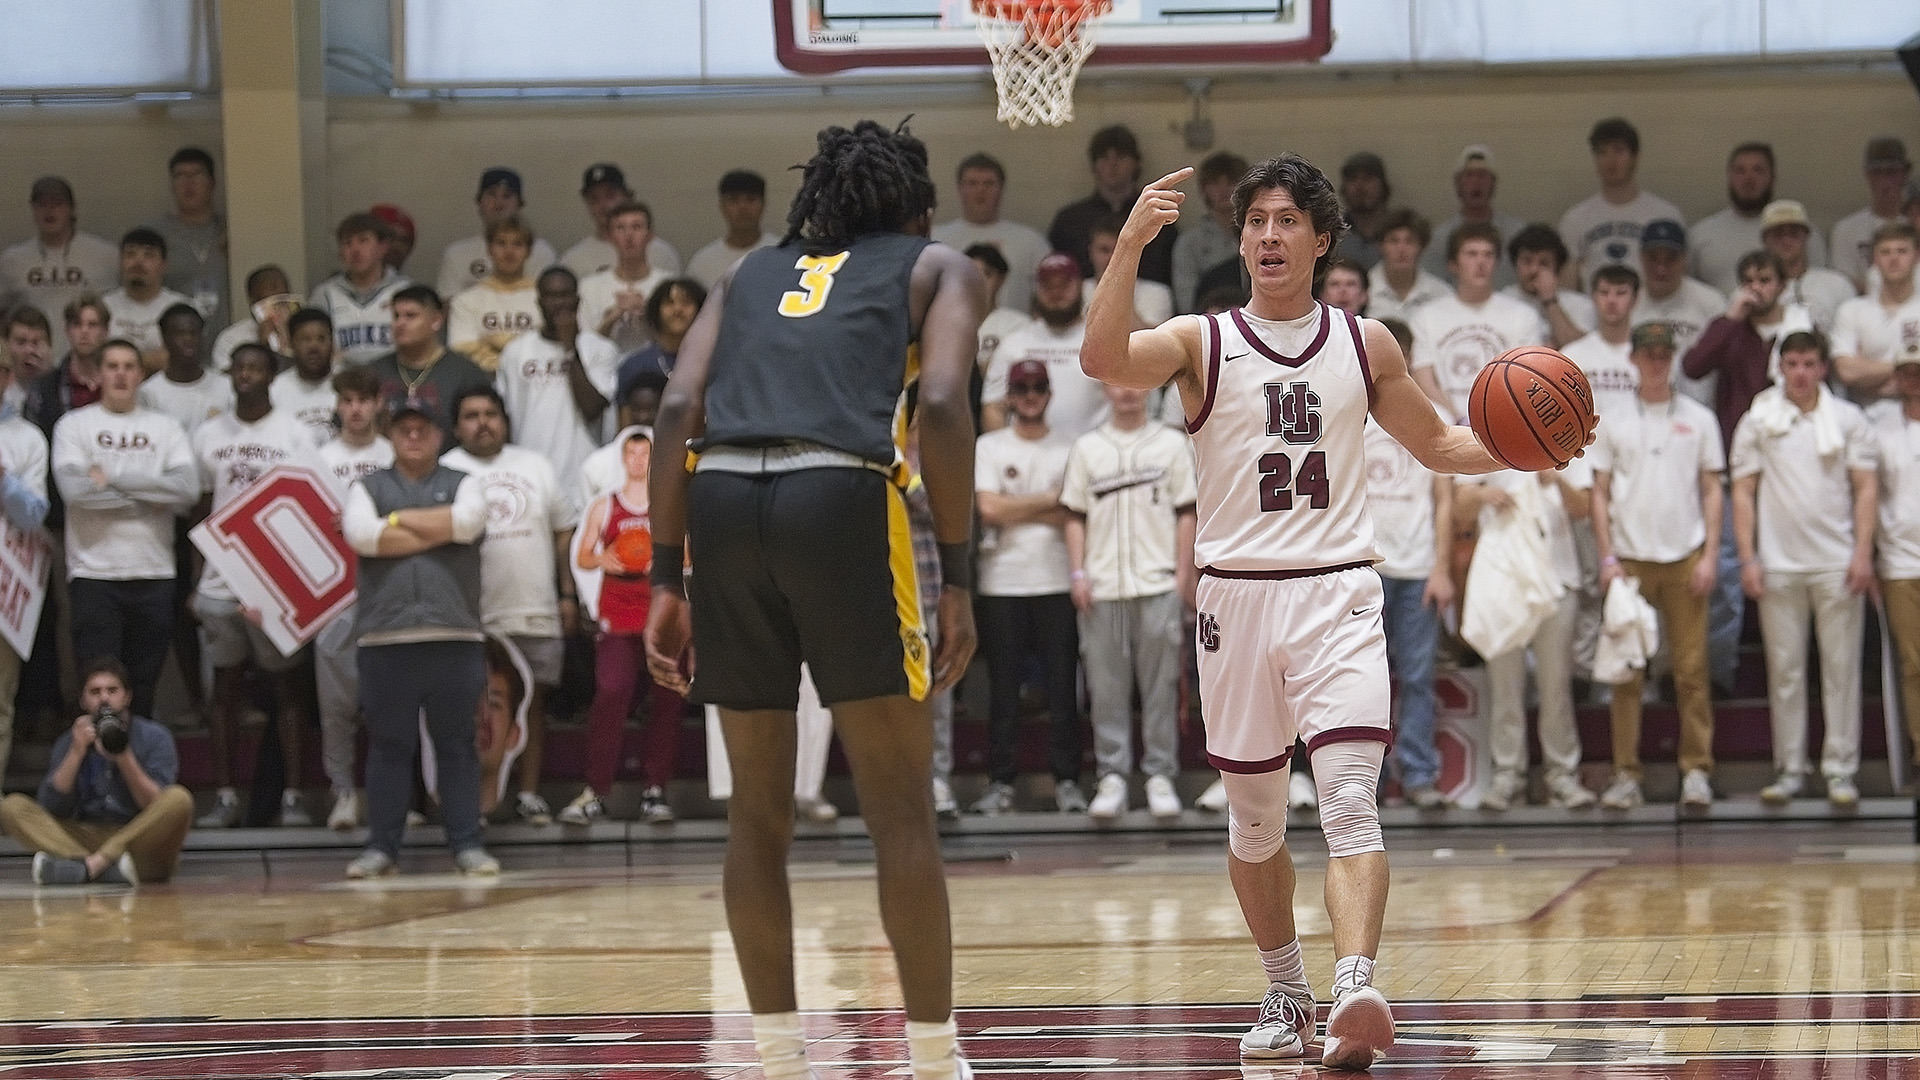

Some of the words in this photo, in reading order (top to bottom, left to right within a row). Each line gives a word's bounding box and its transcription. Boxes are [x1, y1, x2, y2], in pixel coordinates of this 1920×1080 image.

[777, 250, 852, 318] 3
[1526, 382, 1565, 429] ROCK
[1258, 450, 1330, 513] 24
[205, 466, 358, 646] D
